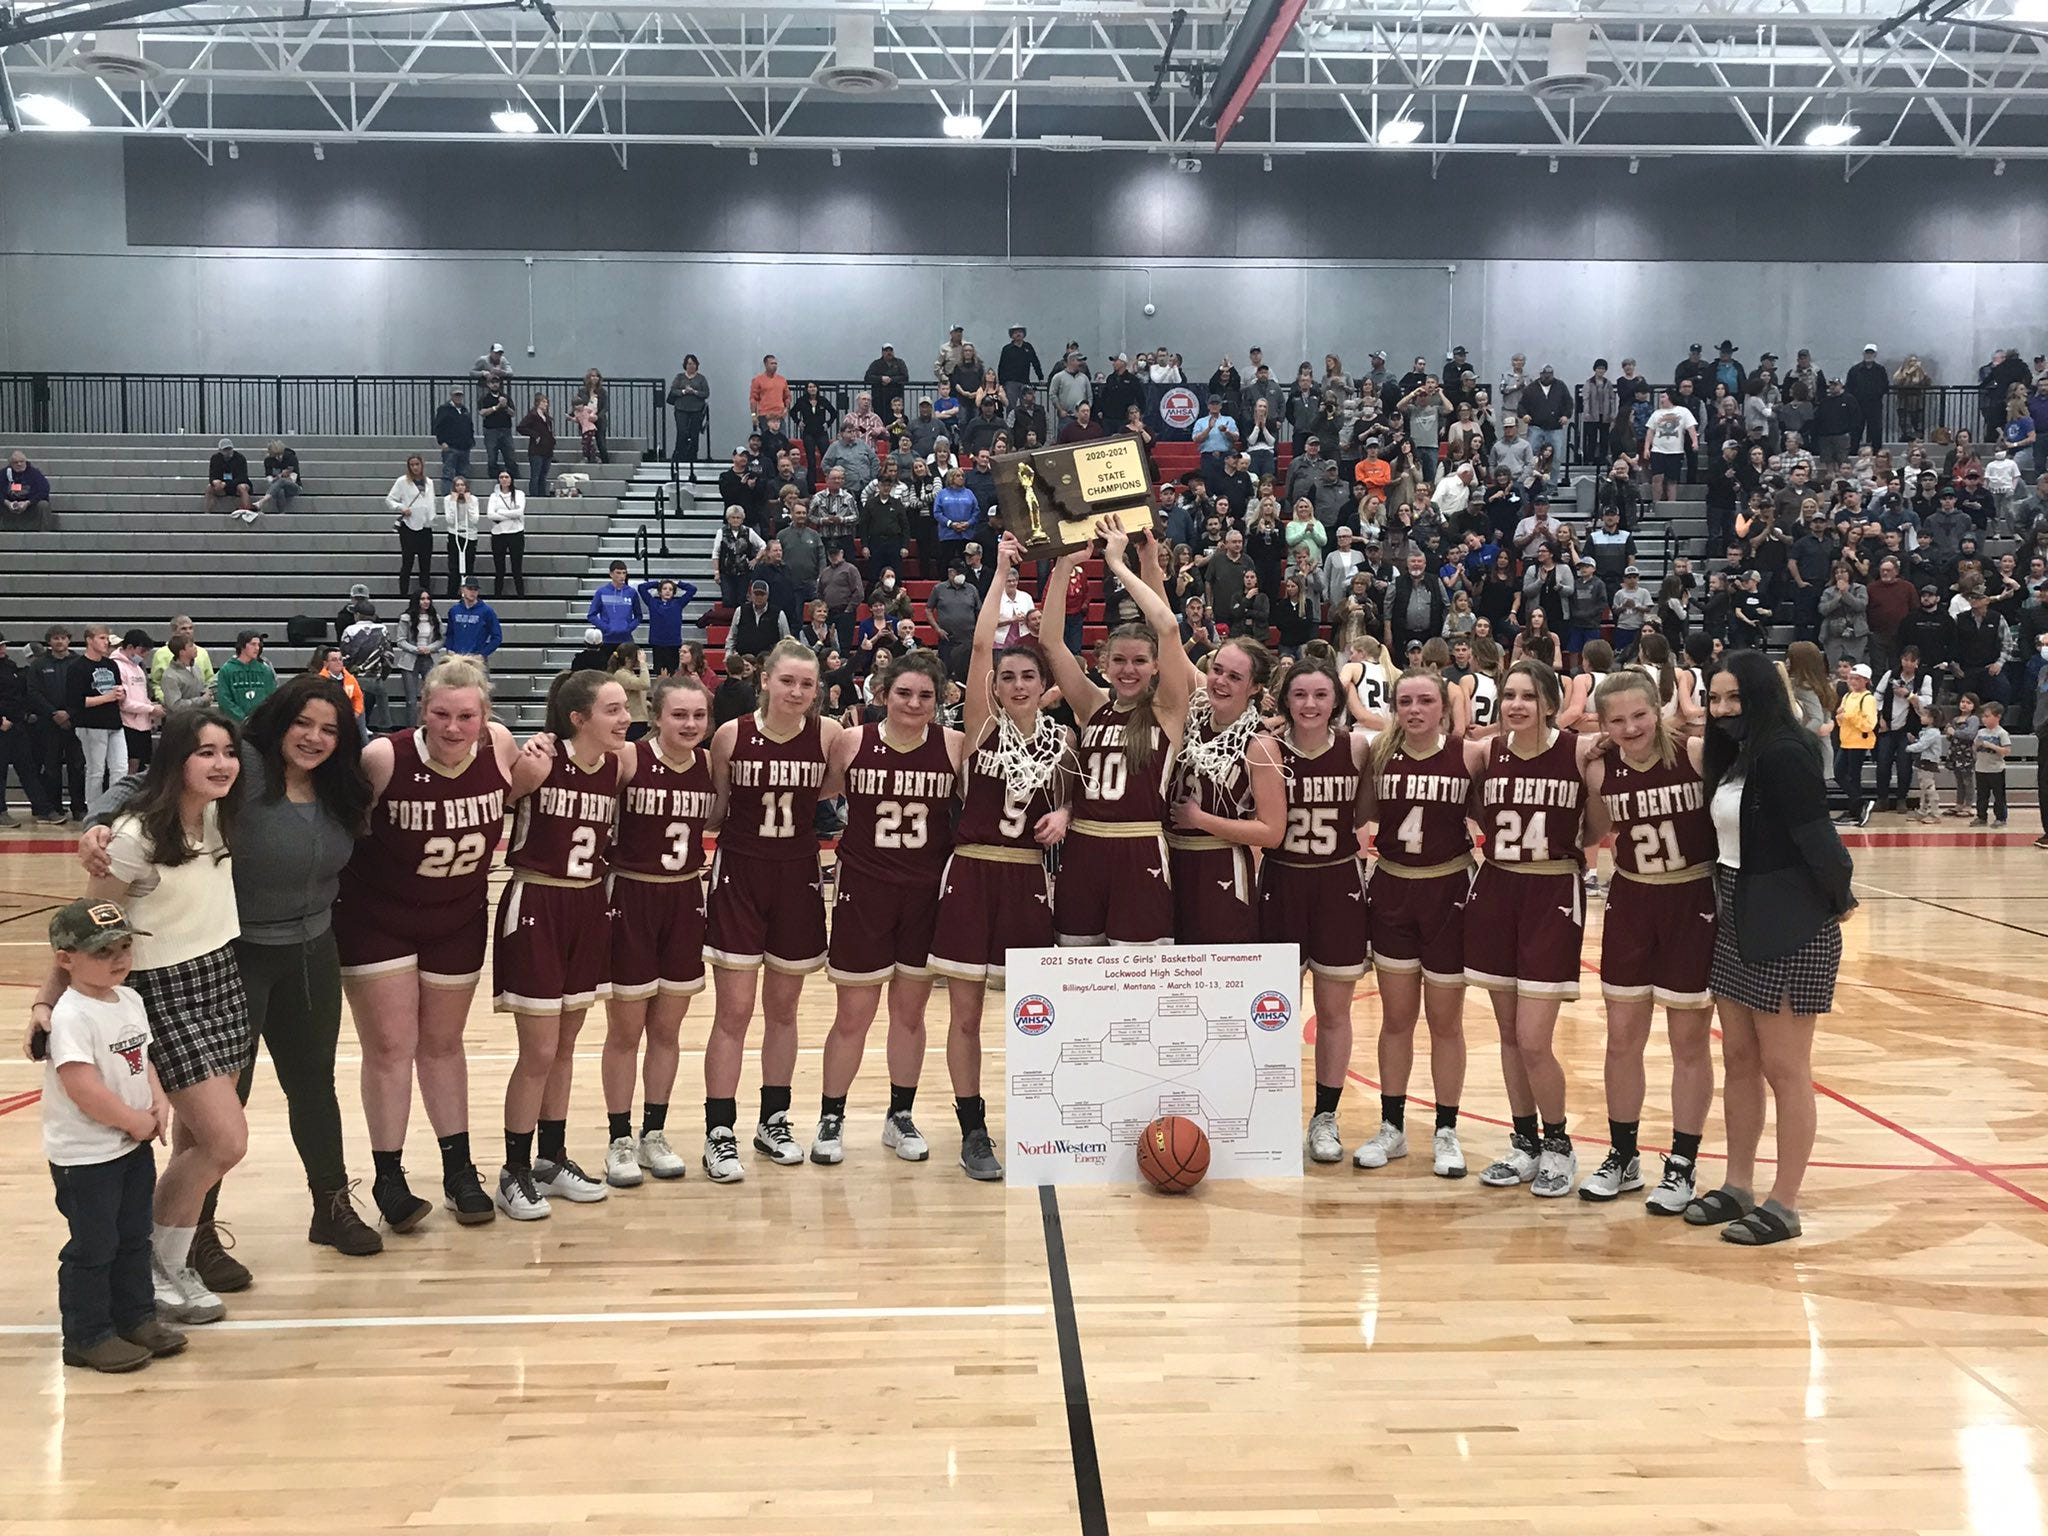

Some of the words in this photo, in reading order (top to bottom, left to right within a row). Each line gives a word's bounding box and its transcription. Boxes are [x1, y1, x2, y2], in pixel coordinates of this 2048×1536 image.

[1165, 408, 1195, 420] MHSA
[1086, 447, 1128, 461] 2020-2021
[1106, 461, 1113, 469] C
[1087, 480, 1142, 496] CHAMPIONS
[1097, 471, 1126, 482] STATE
[769, 760, 826, 788] BENTON
[849, 768, 888, 795] FORT
[893, 770, 954, 798] BENTON
[1085, 752, 1128, 800] 10
[1405, 774, 1471, 804] BENTON
[539, 787, 578, 818] FORT
[626, 786, 668, 816] FORT
[1512, 777, 1580, 809] BENTON
[1636, 781, 1704, 818] BENTON
[388, 800, 437, 831] FORT
[758, 791, 796, 838] 11
[875, 801, 929, 849] 23
[1398, 805, 1424, 854] 4
[1284, 807, 1339, 855] 25
[1494, 810, 1549, 861] 24
[416, 832, 486, 878] 22
[567, 825, 597, 879] 2
[661, 822, 691, 871] 3
[1630, 820, 1687, 874] 21
[1040, 957, 1063, 966] 2021
[1067, 956, 1093, 965] State
[1096, 956, 1120, 965] Class
[1123, 955, 1130, 964] C
[1132, 955, 1157, 964] Girls'
[1161, 954, 1207, 963] Basketball
[1211, 953, 1262, 962] Tournament
[1105, 969, 1147, 978] Lockwood
[1150, 969, 1170, 979] High
[1174, 968, 1203, 977] School
[1062, 983, 1120, 993] Billings/Laurel,
[1123, 983, 1156, 991] Montana
[1167, 981, 1192, 989] March
[1195, 981, 1221, 990] 10-13,
[1225, 980, 1244, 989] 2021
[1017, 1016, 1052, 1026] MHSA
[1254, 1012, 1289, 1022] MHSA
[1017, 1140, 1107, 1156] NorthWestern
[1074, 1154, 1106, 1166] Energy
